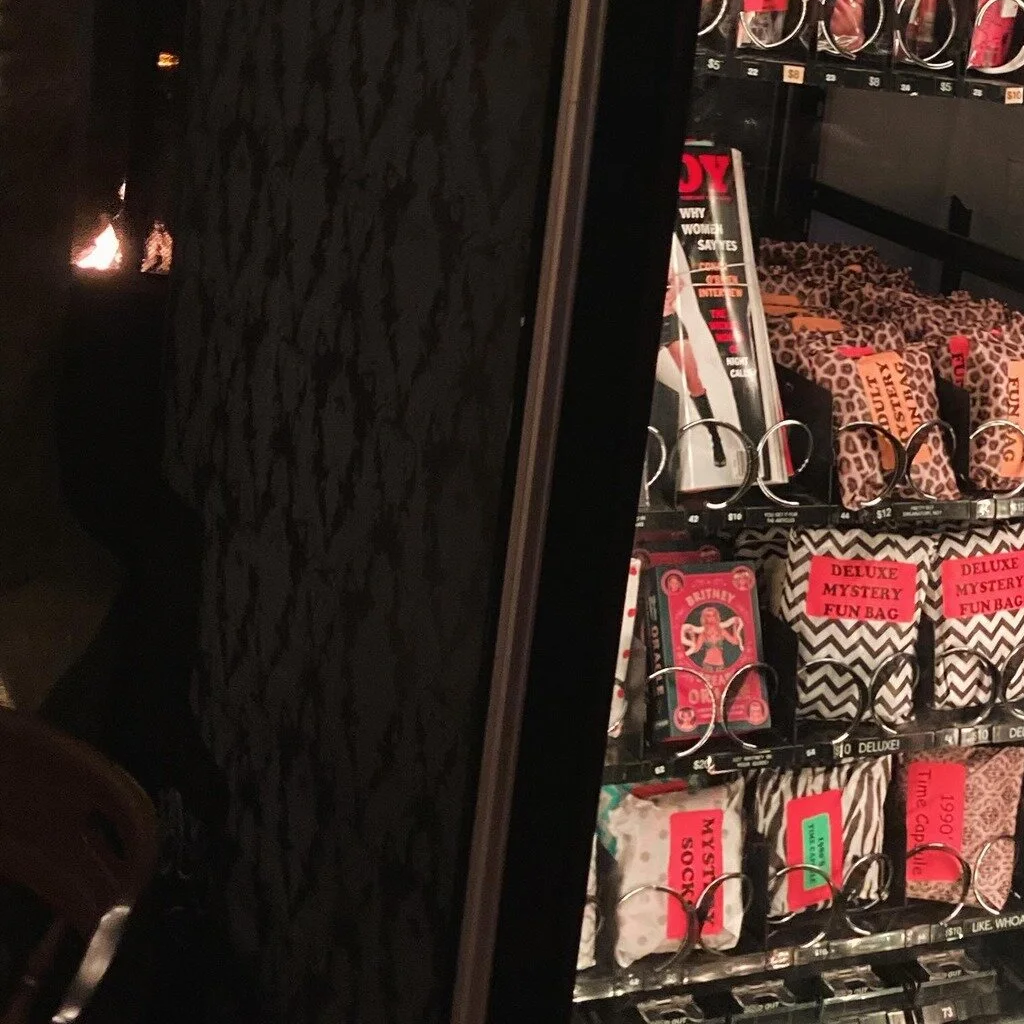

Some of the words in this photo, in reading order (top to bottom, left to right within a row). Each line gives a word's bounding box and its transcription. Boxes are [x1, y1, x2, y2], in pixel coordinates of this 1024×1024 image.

[707, 58, 721, 71] $5
[787, 68, 800, 80] $8
[939, 82, 952, 93] $5
[1006, 89, 1022, 100] $10
[679, 207, 706, 219] WHY
[681, 222, 724, 236] WOMEN
[697, 238, 717, 252] SAY
[718, 239, 738, 252] YES
[865, 375, 890, 432] DULT
[875, 362, 909, 439] YSTERY
[1007, 376, 1020, 417] FUN
[876, 507, 892, 520] $12
[831, 563, 898, 580] DELUXE
[960, 557, 1020, 576] DELUXE
[822, 582, 903, 601] MYSTERY
[955, 575, 1024, 598] MYSTERY
[685, 588, 736, 607] BRITNEY
[959, 600, 991, 616] FUN
[994, 594, 1024, 611] BAG
[823, 603, 861, 617] FUN
[865, 605, 899, 621] BAG
[916, 769, 932, 808] Time
[939, 795, 955, 841] 1990'
[681, 836, 696, 906] SOCK
[701, 817, 717, 927] MYSTY
[941, 1007, 954, 1019] 73
